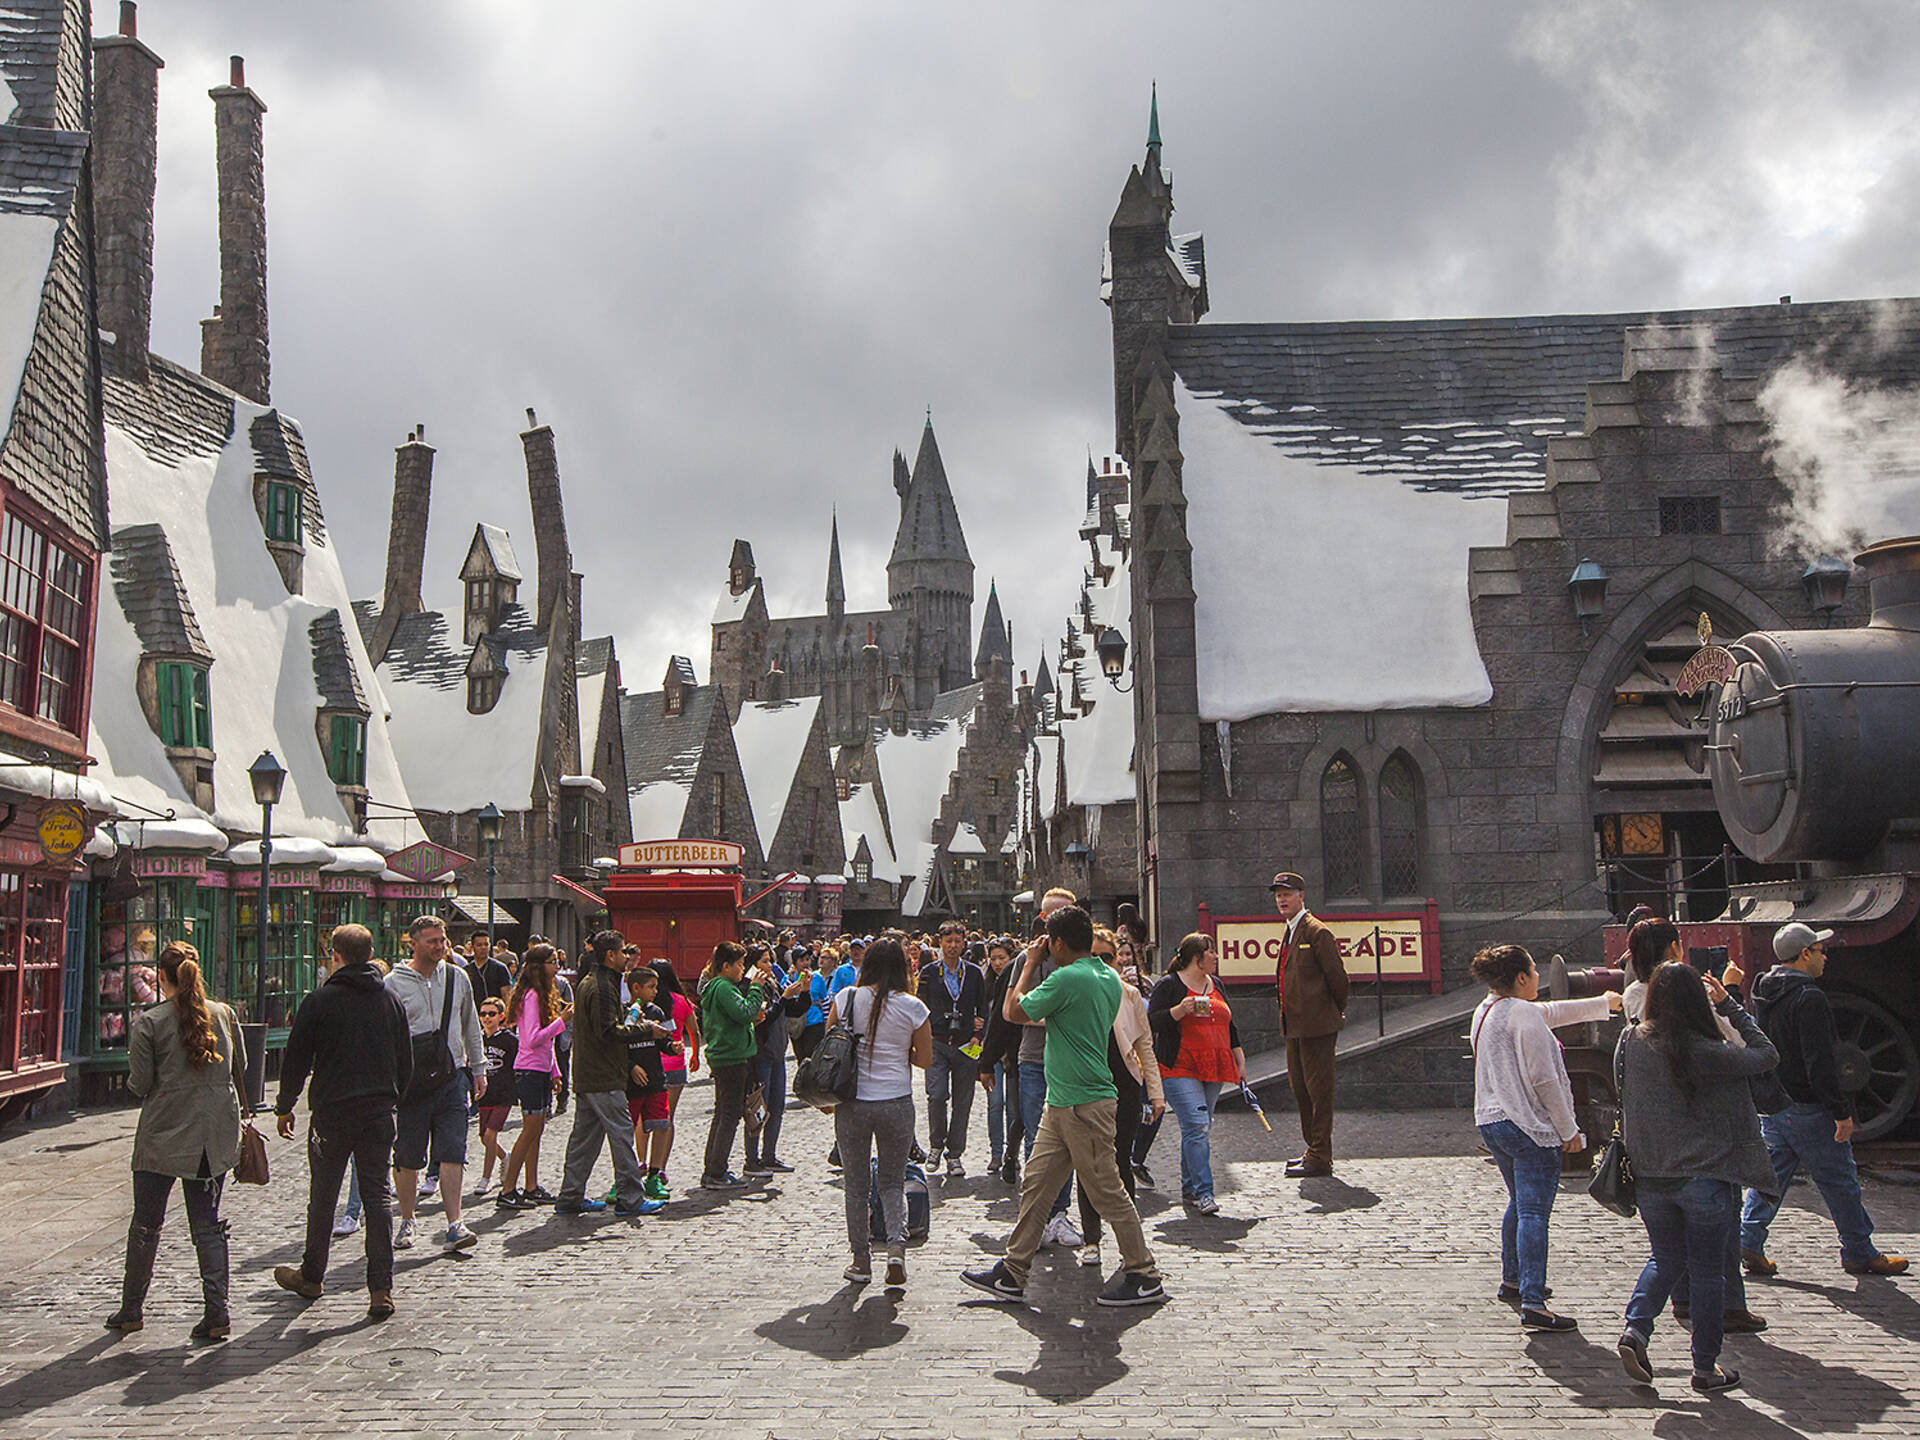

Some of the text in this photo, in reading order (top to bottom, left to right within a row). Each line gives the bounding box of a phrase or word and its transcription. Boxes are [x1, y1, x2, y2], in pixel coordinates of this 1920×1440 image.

[1717, 696, 1742, 721] 5972
[634, 845, 729, 863] BUTTERBEER
[1222, 936, 1417, 960] HOGEADE
